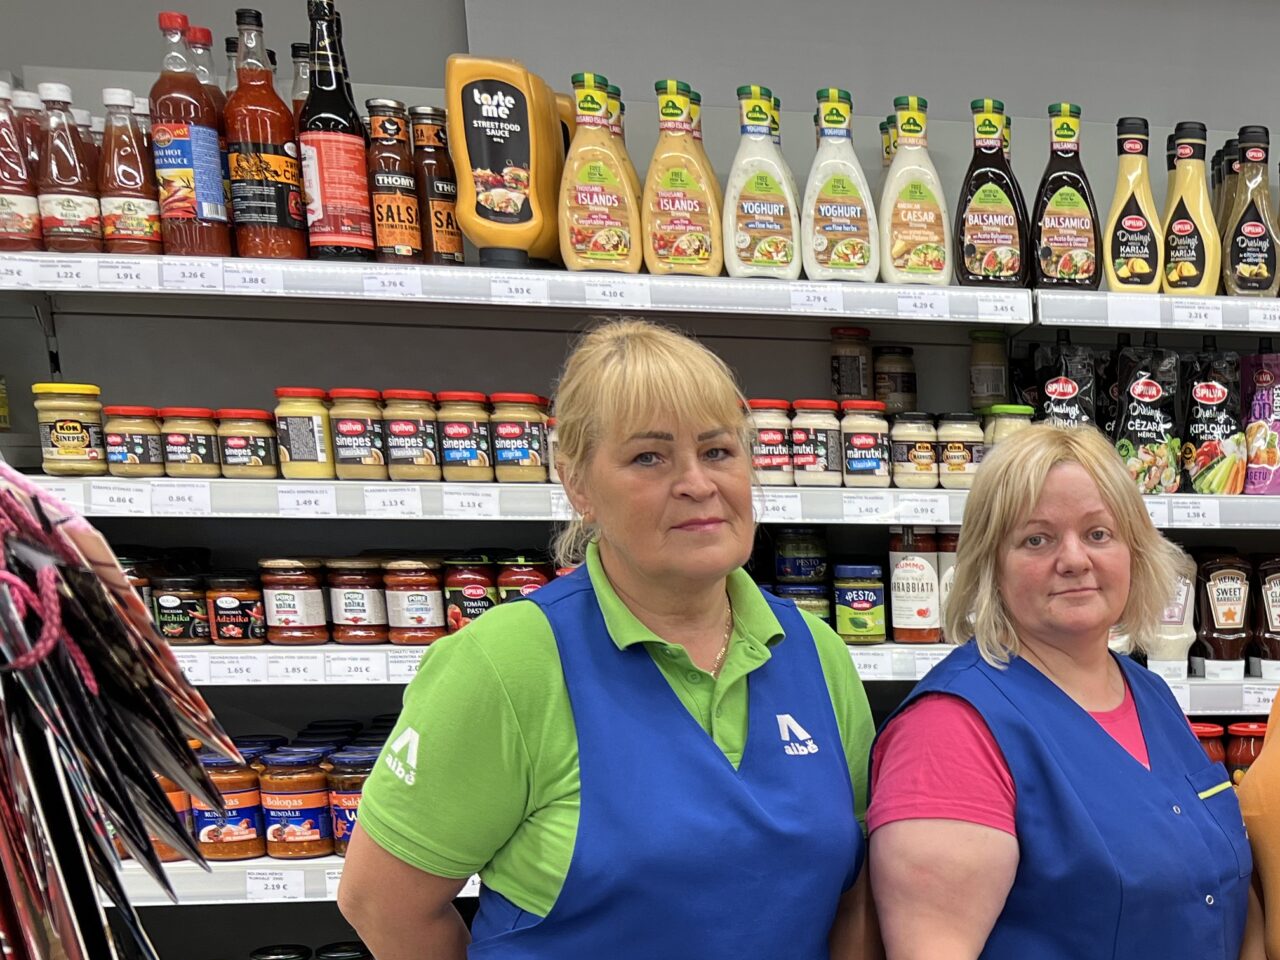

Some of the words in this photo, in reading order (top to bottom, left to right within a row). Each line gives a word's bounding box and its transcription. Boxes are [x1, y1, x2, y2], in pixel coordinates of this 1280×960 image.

[473, 88, 516, 108] taste
[482, 105, 509, 119] me
[472, 120, 499, 131] STREET
[500, 122, 521, 132] FOOD
[486, 129, 510, 138] SAUCE
[824, 128, 848, 137] YOGHURT
[376, 175, 415, 188] THOMY
[578, 192, 619, 207] ISLANDS
[660, 199, 700, 213] ISLANDS
[742, 202, 785, 216] YOGHURT
[819, 205, 862, 219] YOGHURT
[901, 211, 935, 222] CAESAR
[968, 213, 1015, 226] BALSAMICO
[1045, 217, 1090, 230] BALSAMICO
[1120, 246, 1149, 255] KARIJA
[1170, 250, 1196, 258] KARIJA
[1046, 383, 1077, 396] SPILVA
[1194, 387, 1226, 400] SPILVA
[59, 424, 80, 433] KOK
[1127, 418, 1163, 432] CĒZARA
[55, 434, 86, 443] SINEPES
[336, 436, 371, 449] sinepes
[389, 436, 423, 449] sinepes
[443, 438, 477, 451] sinepes
[495, 438, 528, 450] sinepes
[1218, 575, 1240, 586] HEINZ
[891, 581, 934, 593] ARRABBIATA
[1216, 587, 1242, 598] SWEET
[847, 590, 875, 602] PESTO
[463, 600, 489, 608] TOMĀTU
[270, 809, 301, 818] RUNDĀLE
[264, 883, 281, 891] 2.19
